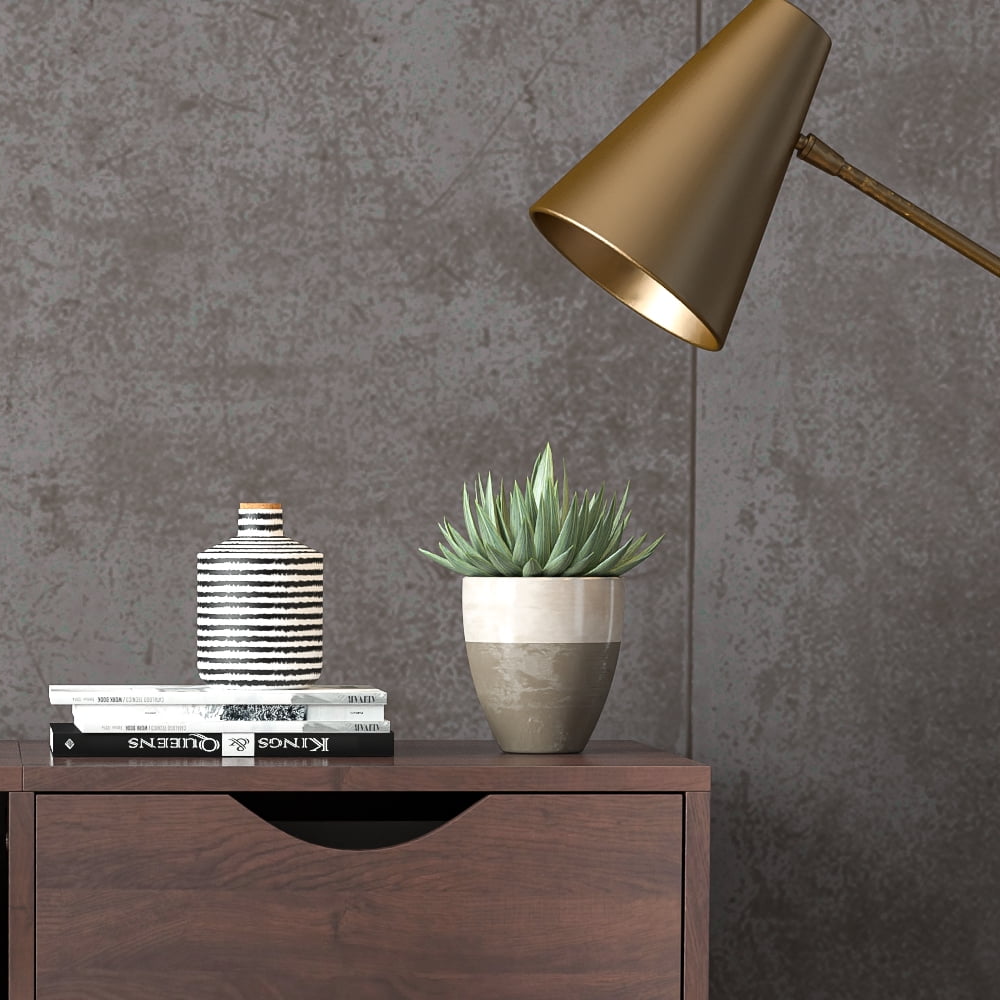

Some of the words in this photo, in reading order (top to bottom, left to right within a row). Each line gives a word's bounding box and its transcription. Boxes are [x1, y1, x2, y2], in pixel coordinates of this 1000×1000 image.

[127, 733, 221, 753] QUEENS
[227, 737, 250, 752] &
[257, 737, 330, 752] KINGS
